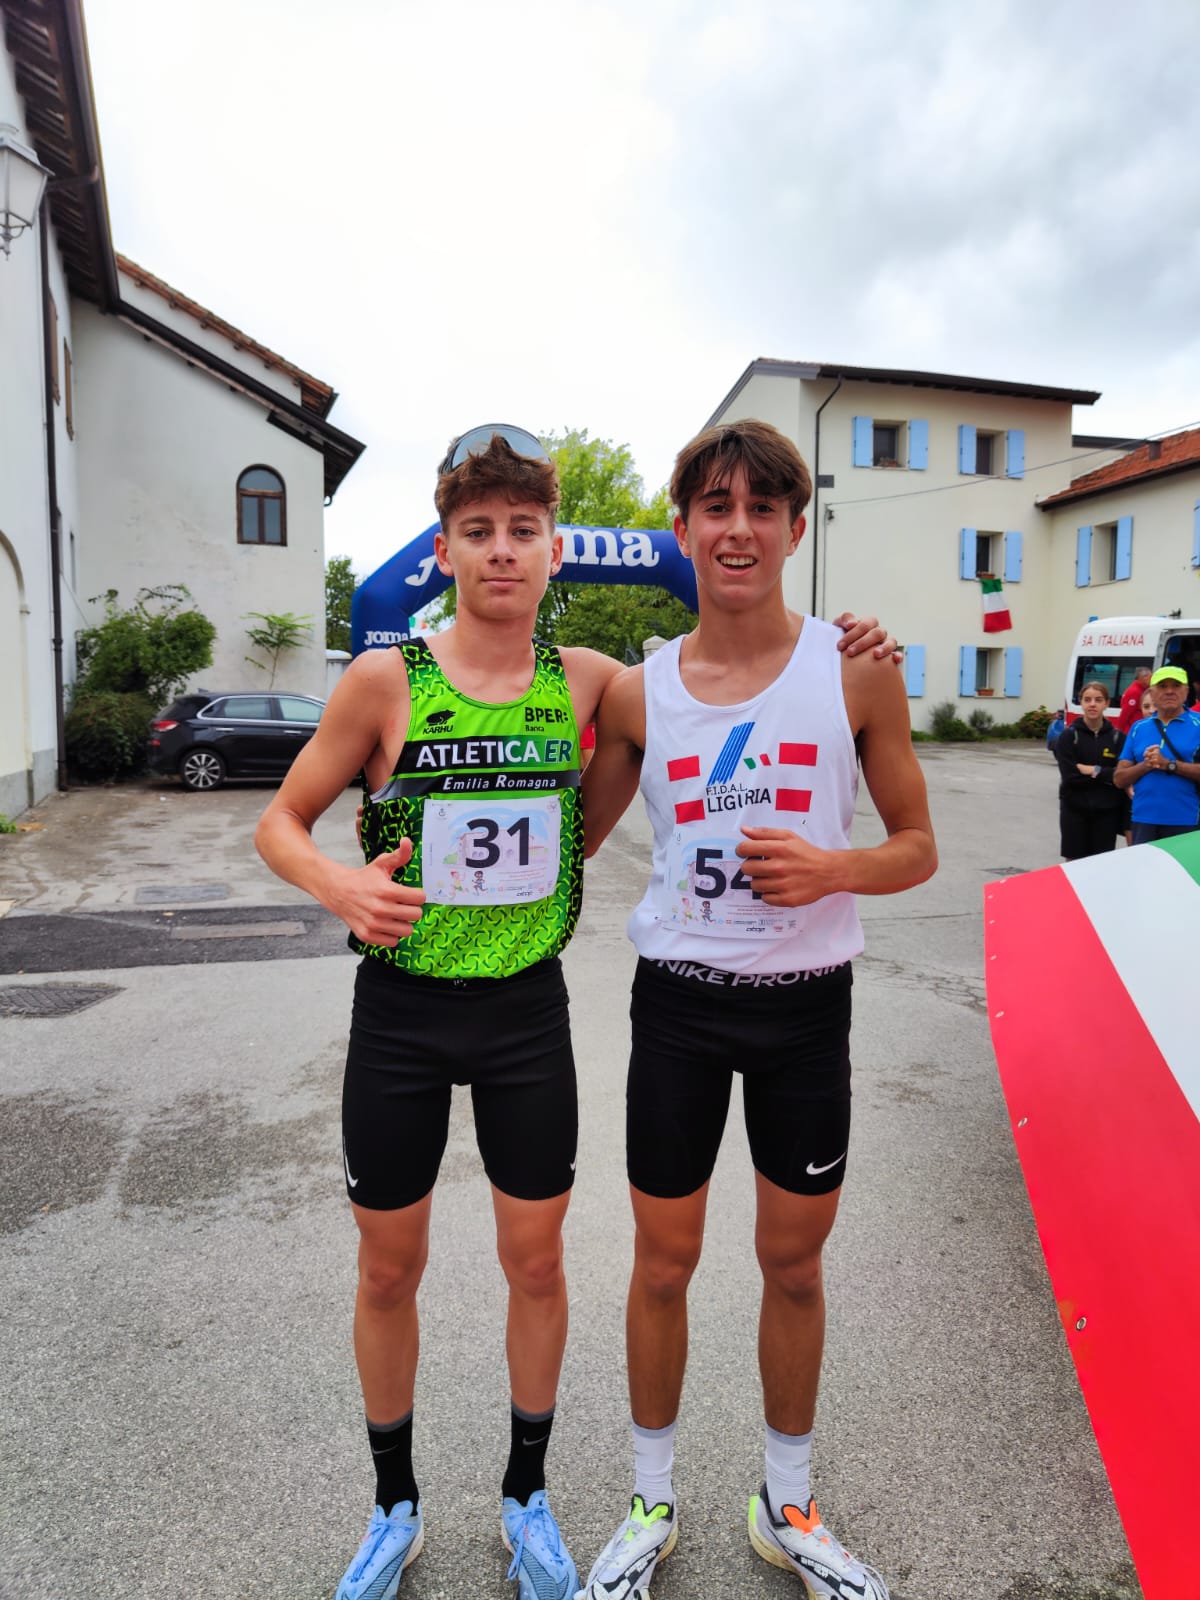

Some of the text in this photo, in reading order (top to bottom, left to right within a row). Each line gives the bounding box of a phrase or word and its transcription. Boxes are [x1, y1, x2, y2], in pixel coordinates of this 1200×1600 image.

[404, 527, 660, 587] Jma
[1098, 633, 1145, 647] ITALIANA
[524, 706, 569, 724] BPER:
[423, 724, 454, 735] KARHU
[525, 725, 545, 733] Banca
[415, 738, 574, 769] ATLETICA ER
[442, 774, 557, 791] Emilia Romagna
[465, 817, 530, 869] 31
[656, 959, 729, 985] NIKE
[730, 972, 800, 988] PRO
